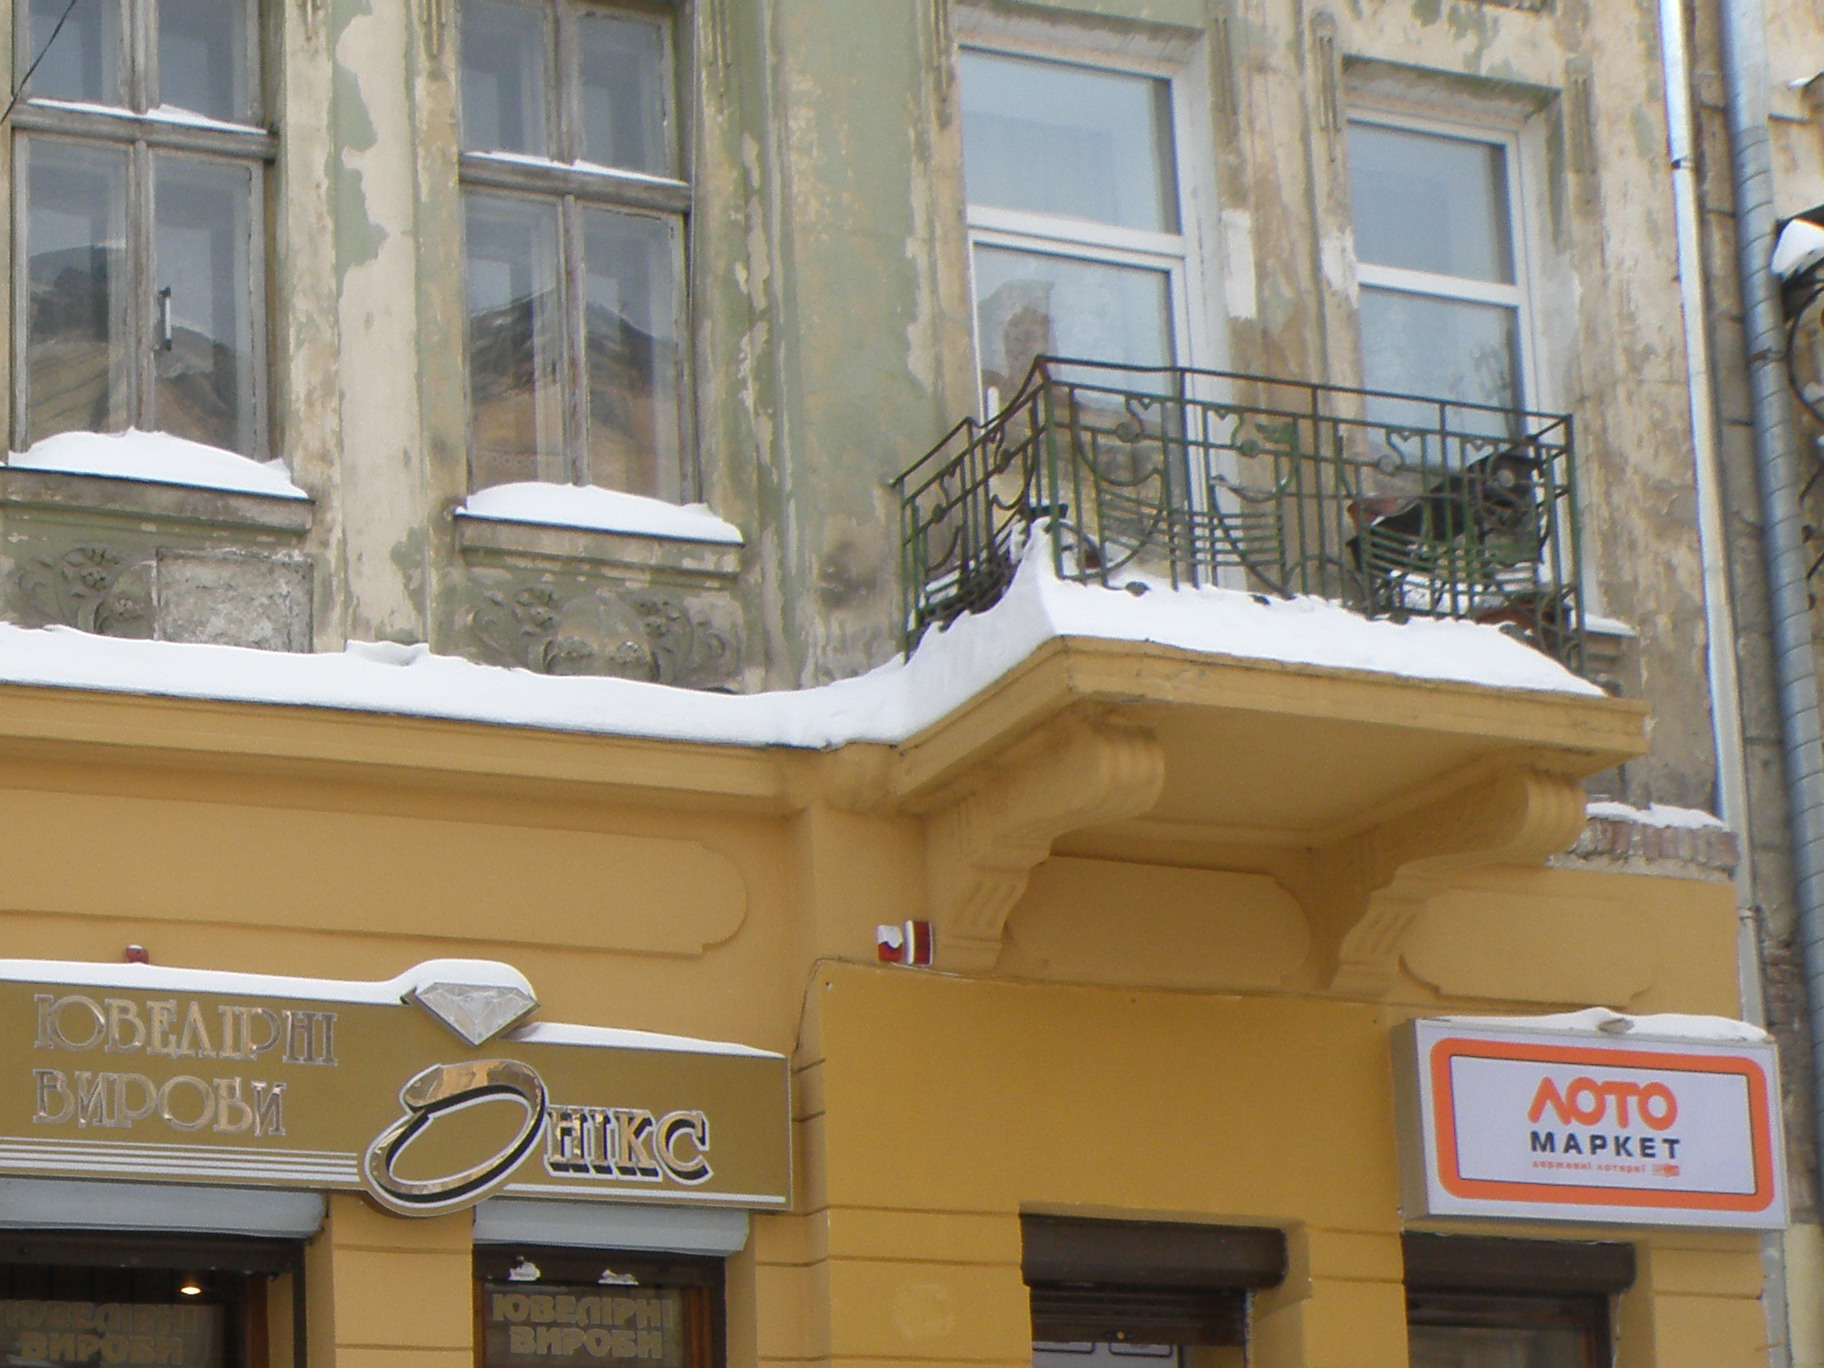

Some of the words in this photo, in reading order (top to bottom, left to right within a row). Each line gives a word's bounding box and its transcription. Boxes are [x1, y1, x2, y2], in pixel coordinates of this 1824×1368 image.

[33, 994, 339, 1067] ЮВЕЛІРНІ
[33, 1068, 287, 1137] ВИРОБИ
[1527, 1076, 1678, 1131] ЛОТО
[1530, 1130, 1682, 1160] МАРКЕТ
[491, 1292, 674, 1330] ЮВЕЛІРНІ
[20, 1332, 183, 1366] ВИРОБИ
[510, 1325, 664, 1360] ВИРОБИ
